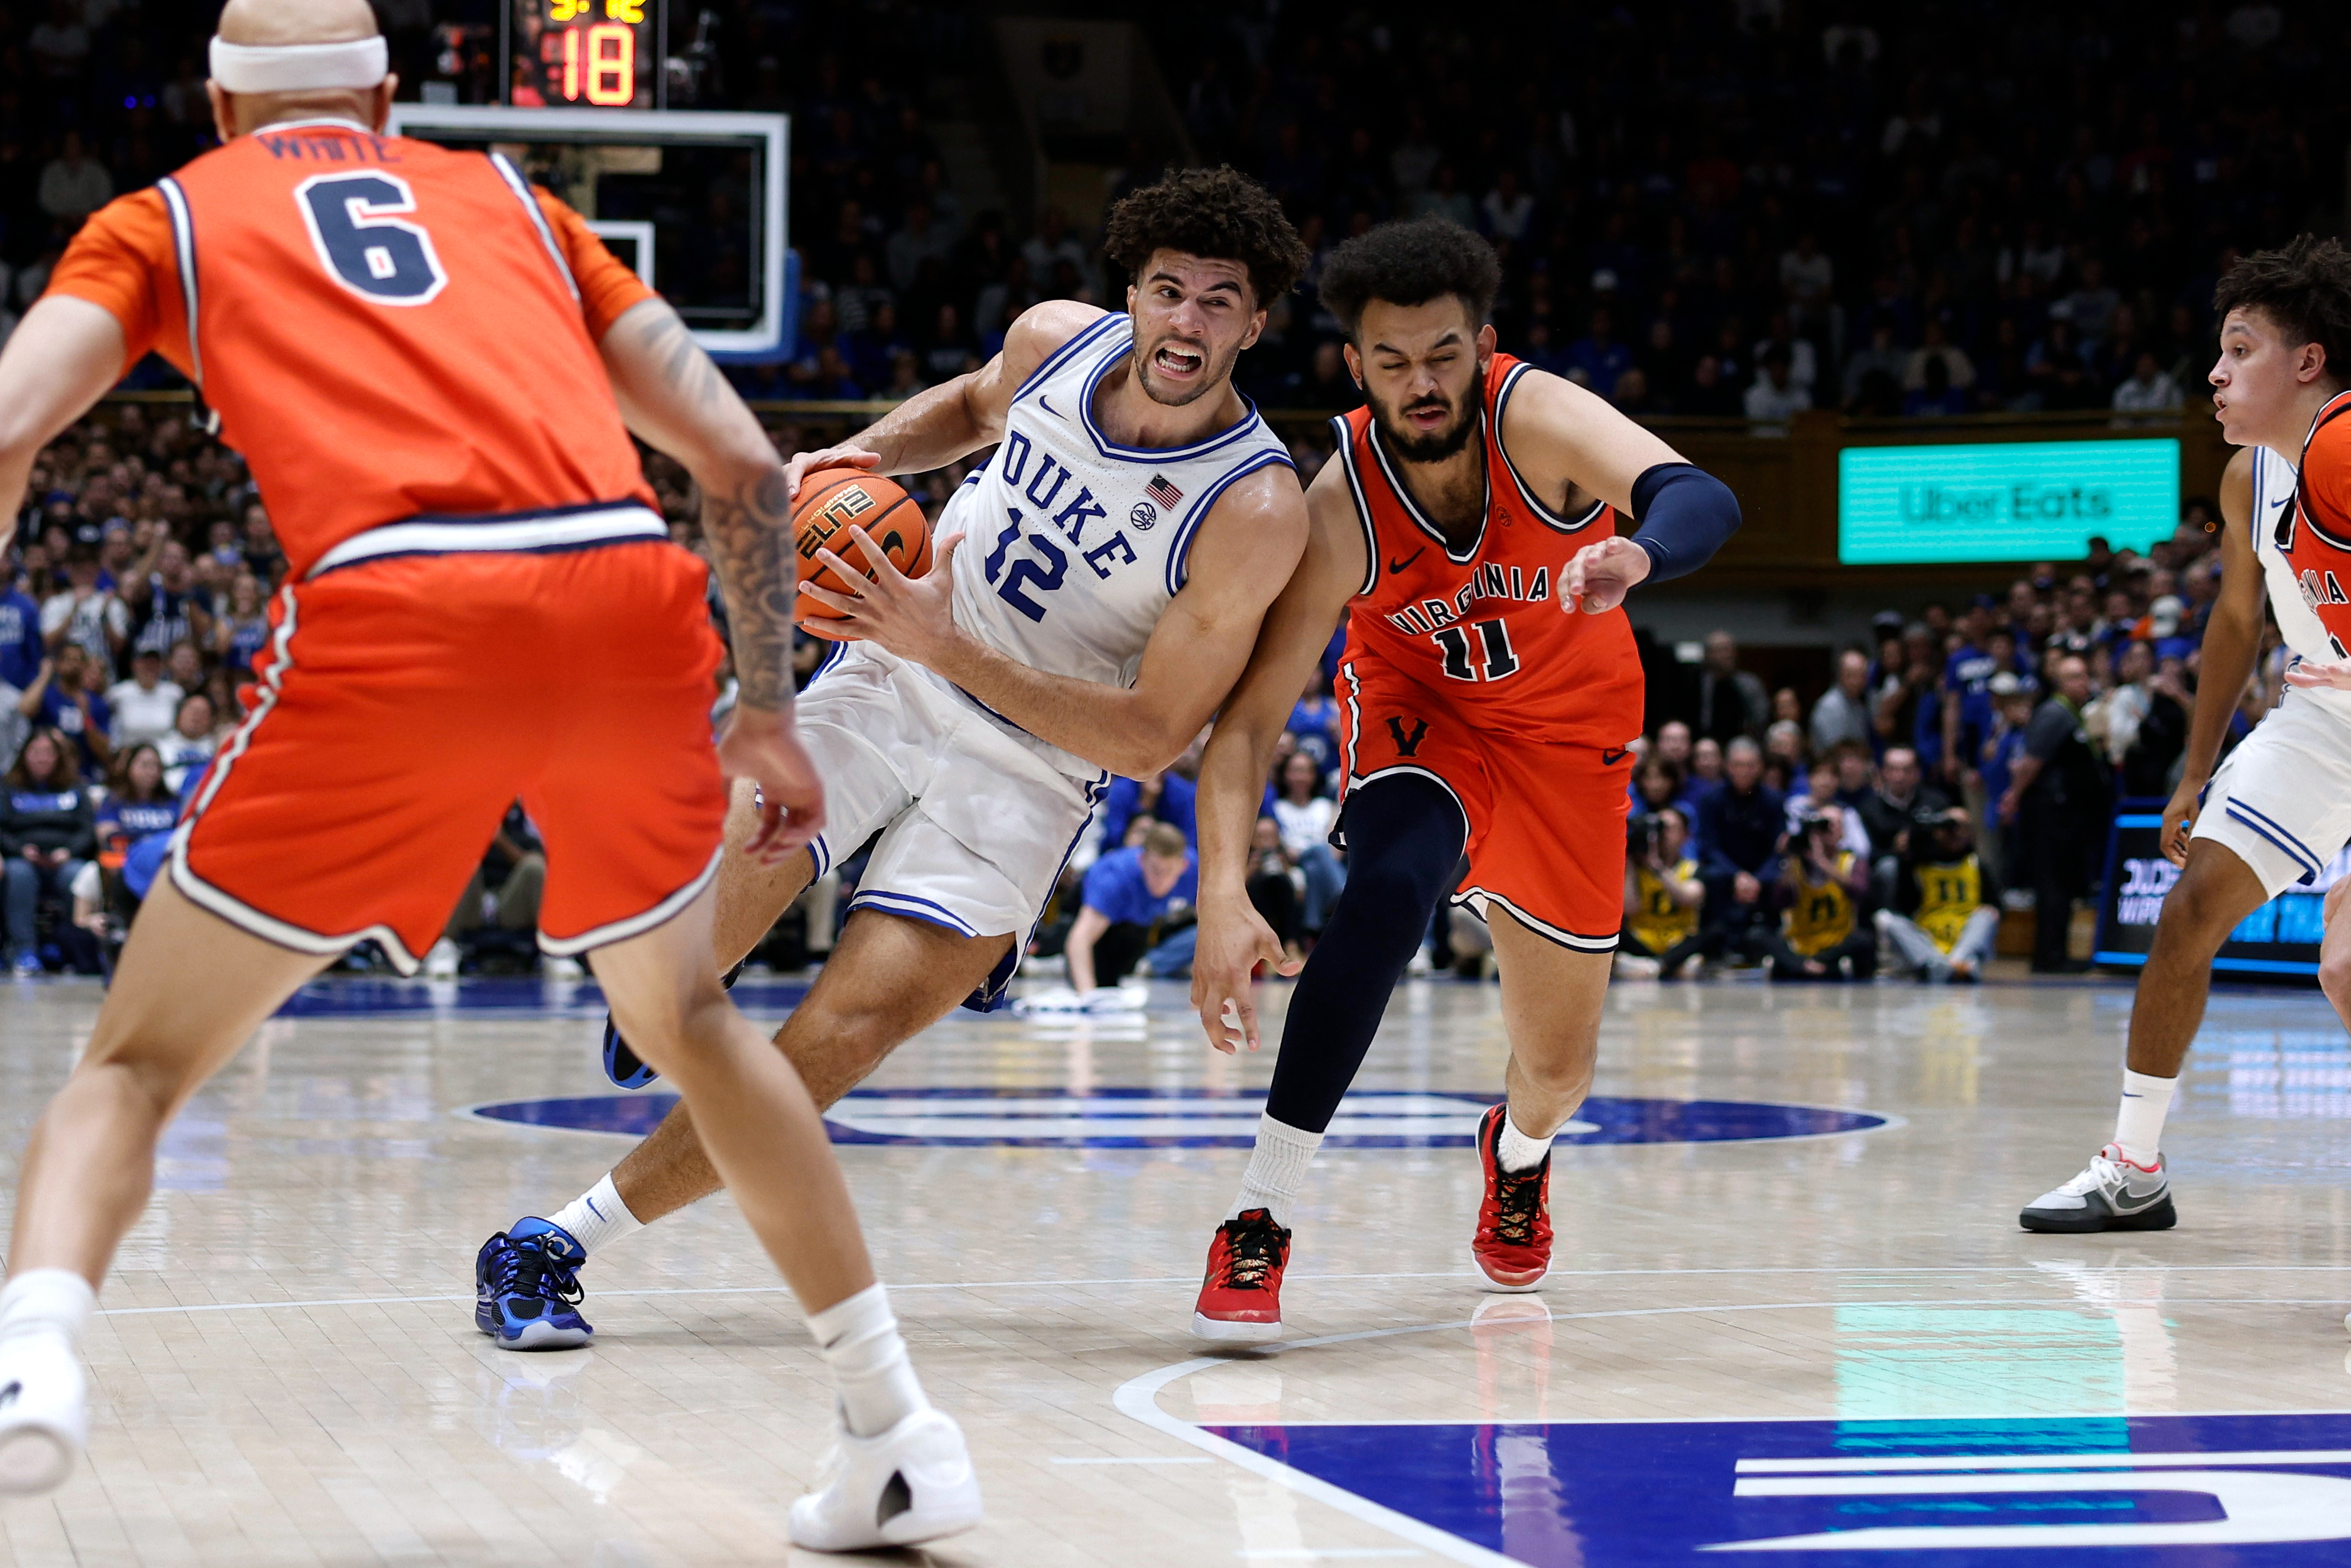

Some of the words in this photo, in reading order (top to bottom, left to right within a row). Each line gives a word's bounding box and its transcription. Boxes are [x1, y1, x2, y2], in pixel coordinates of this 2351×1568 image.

[563, 22, 635, 106] 18
[256, 134, 402, 163] WHITE
[293, 168, 449, 307] 6
[796, 488, 877, 561] ELITE
[1002, 430, 1138, 580] DUKE
[1135, 509, 1155, 526] ACC
[1899, 481, 1999, 524] Uber
[2011, 480, 2113, 522] Eats
[984, 508, 1069, 624] 12
[1384, 560, 1549, 635] VIRGINIA
[1429, 618, 1521, 683] 11
[1383, 715, 1434, 758] V
